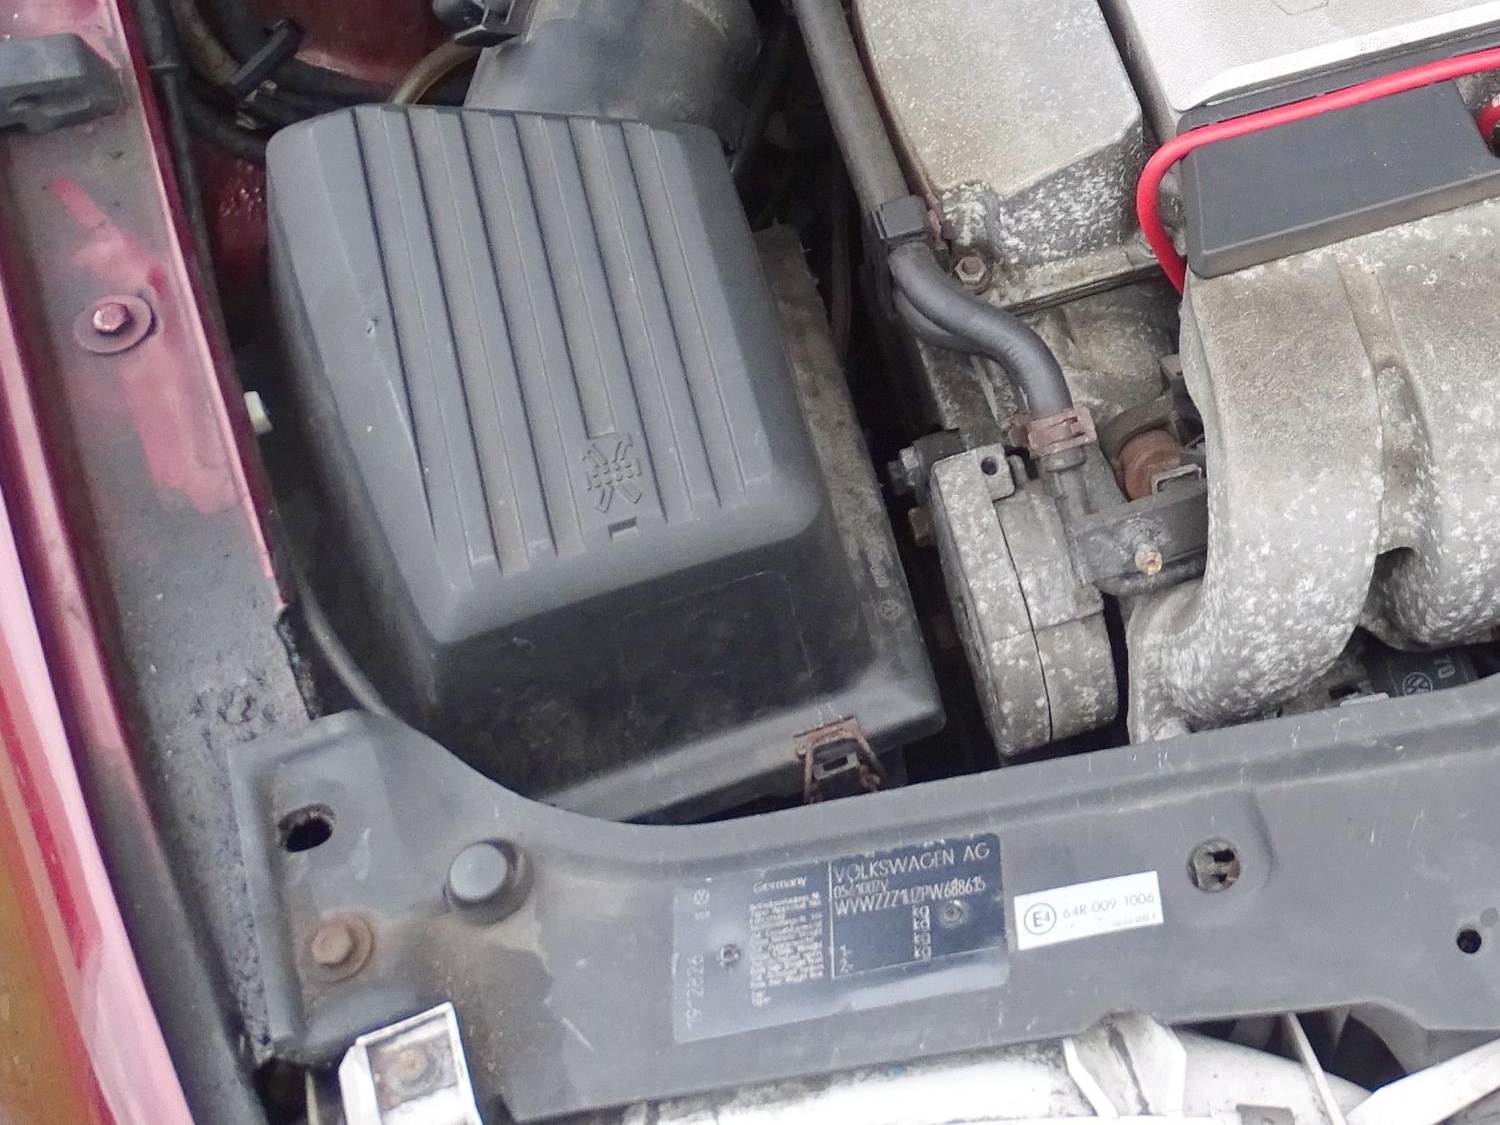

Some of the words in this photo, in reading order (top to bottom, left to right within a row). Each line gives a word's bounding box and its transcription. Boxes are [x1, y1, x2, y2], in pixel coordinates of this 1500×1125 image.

[832, 846, 955, 886] VOLKSWAGEN
[961, 839, 991, 863] AG
[752, 873, 808, 896] Germany
[910, 901, 930, 920] kg
[1061, 896, 1117, 919] 64R-009
[1123, 889, 1155, 908] 1006
[911, 914, 931, 934] kg
[912, 928, 932, 948] kg
[913, 941, 932, 964] kg
